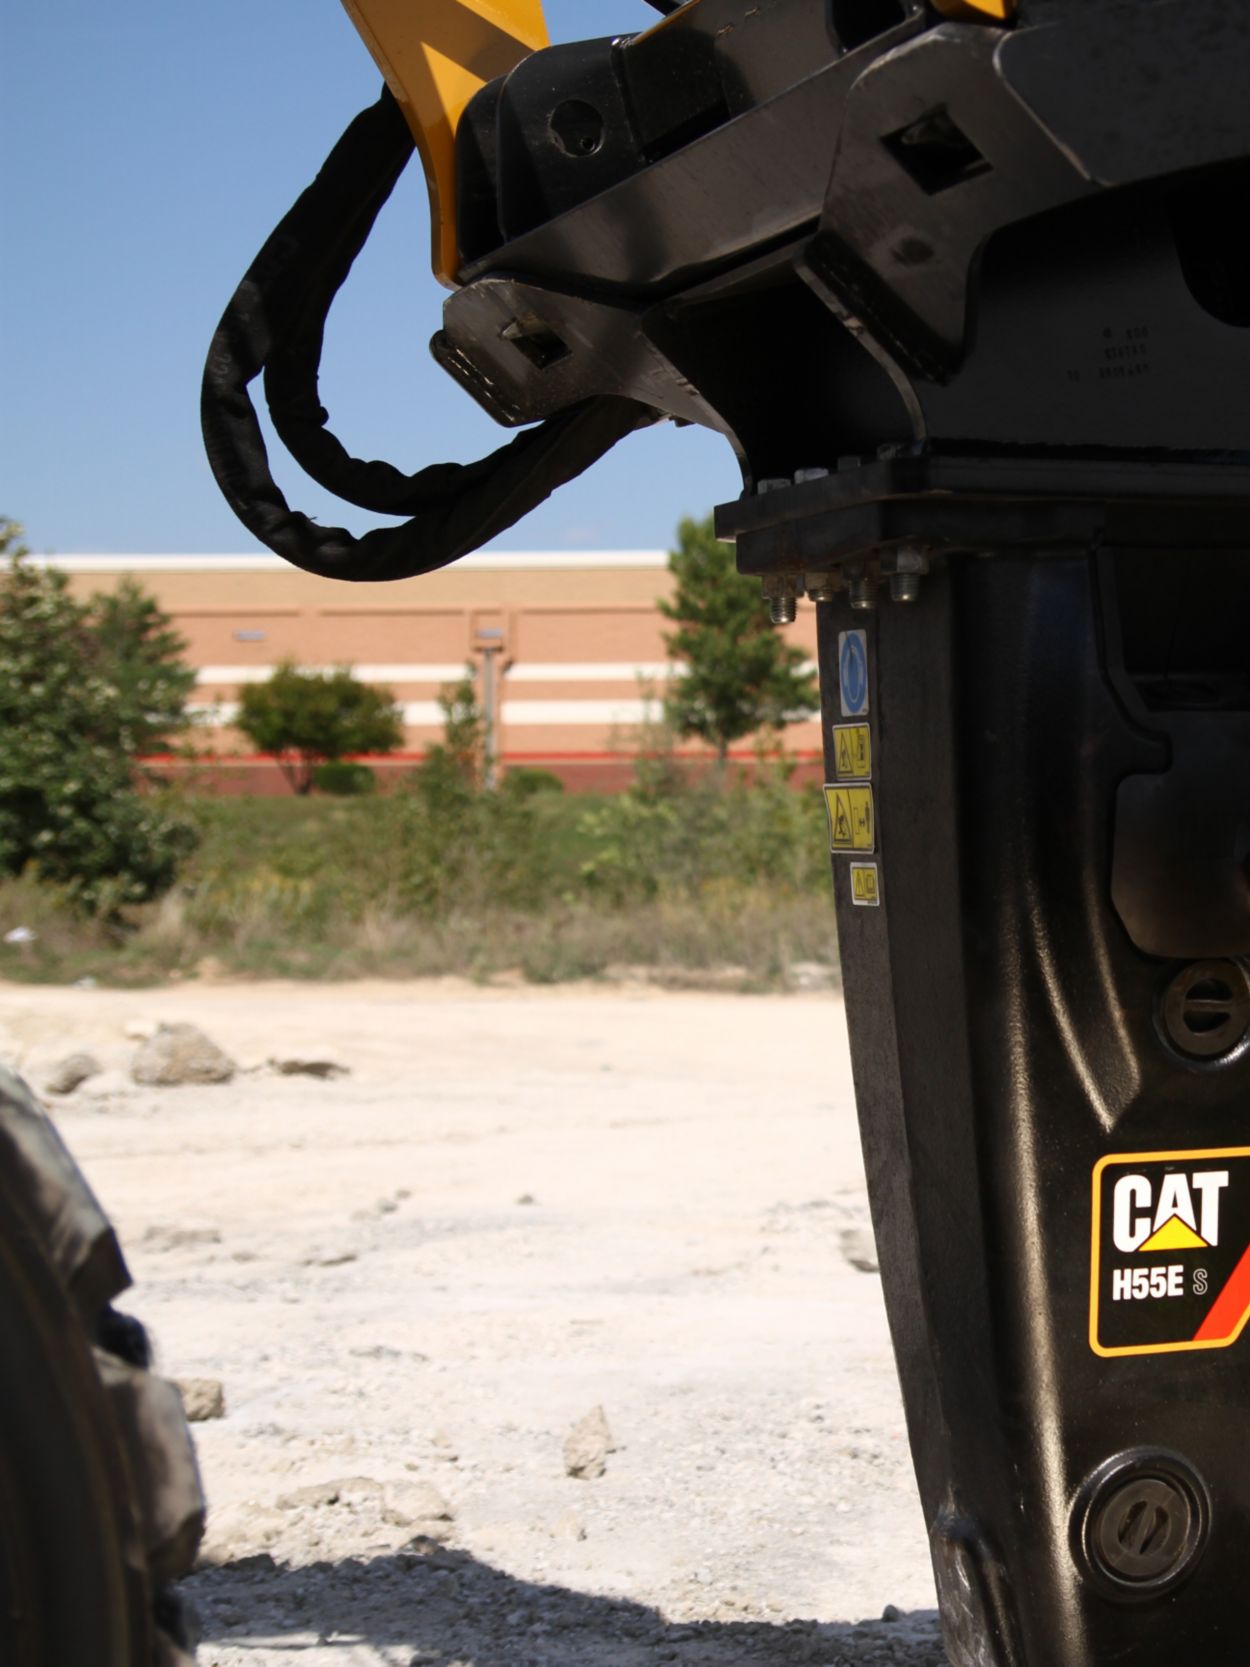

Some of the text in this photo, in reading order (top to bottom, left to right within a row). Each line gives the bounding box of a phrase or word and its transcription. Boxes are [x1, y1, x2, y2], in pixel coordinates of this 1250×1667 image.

[1113, 1170, 1229, 1253] CAT
[1112, 1264, 1208, 1301] H55E S
